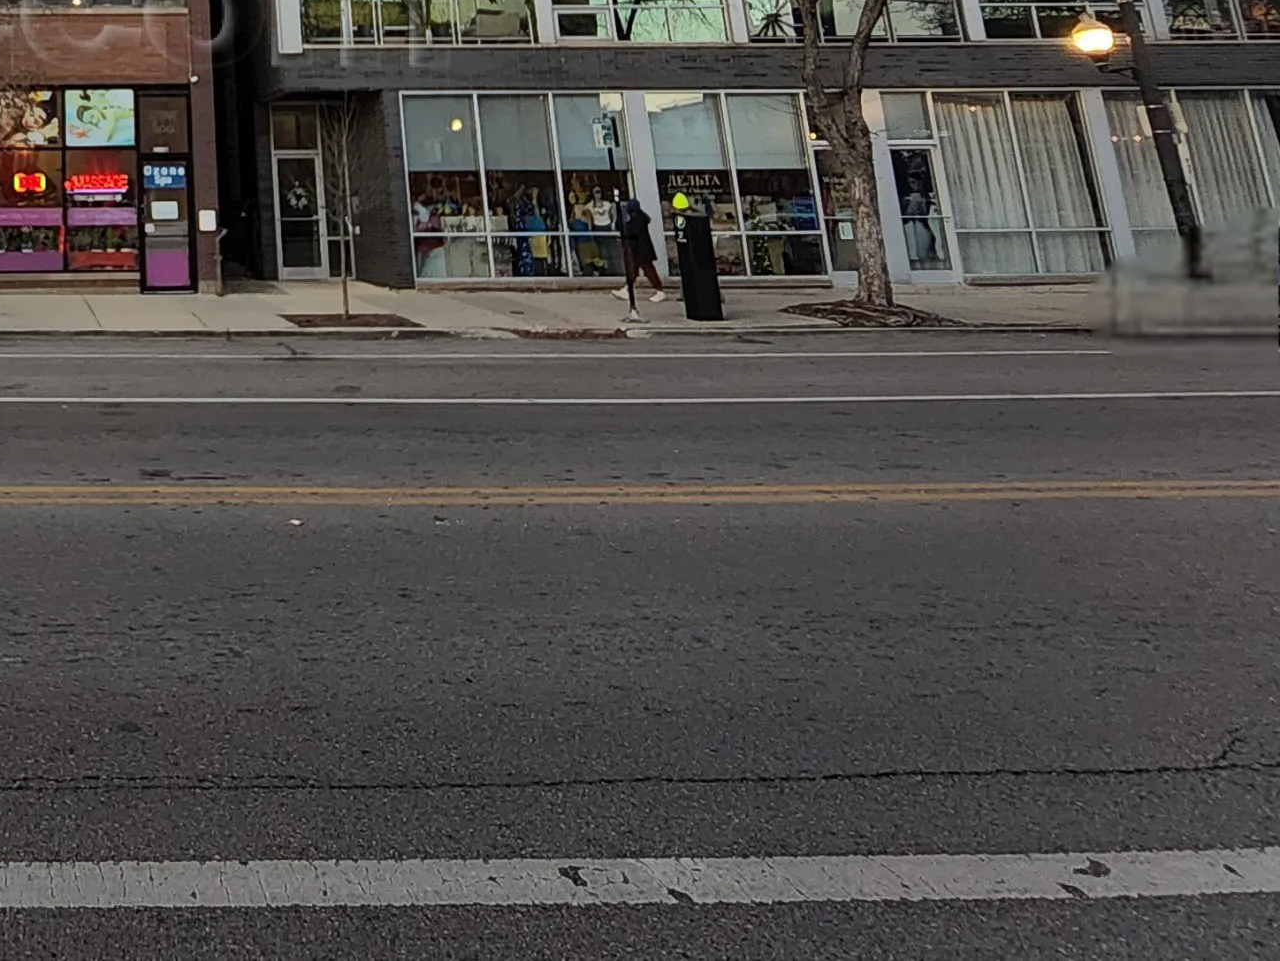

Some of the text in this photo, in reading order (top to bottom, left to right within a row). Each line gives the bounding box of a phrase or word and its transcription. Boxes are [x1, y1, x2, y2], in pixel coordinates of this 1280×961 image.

[143, 165, 185, 176] Ozone
[71, 174, 129, 190] MASSAGE
[667, 174, 721, 187] ДЕЛЬТА
